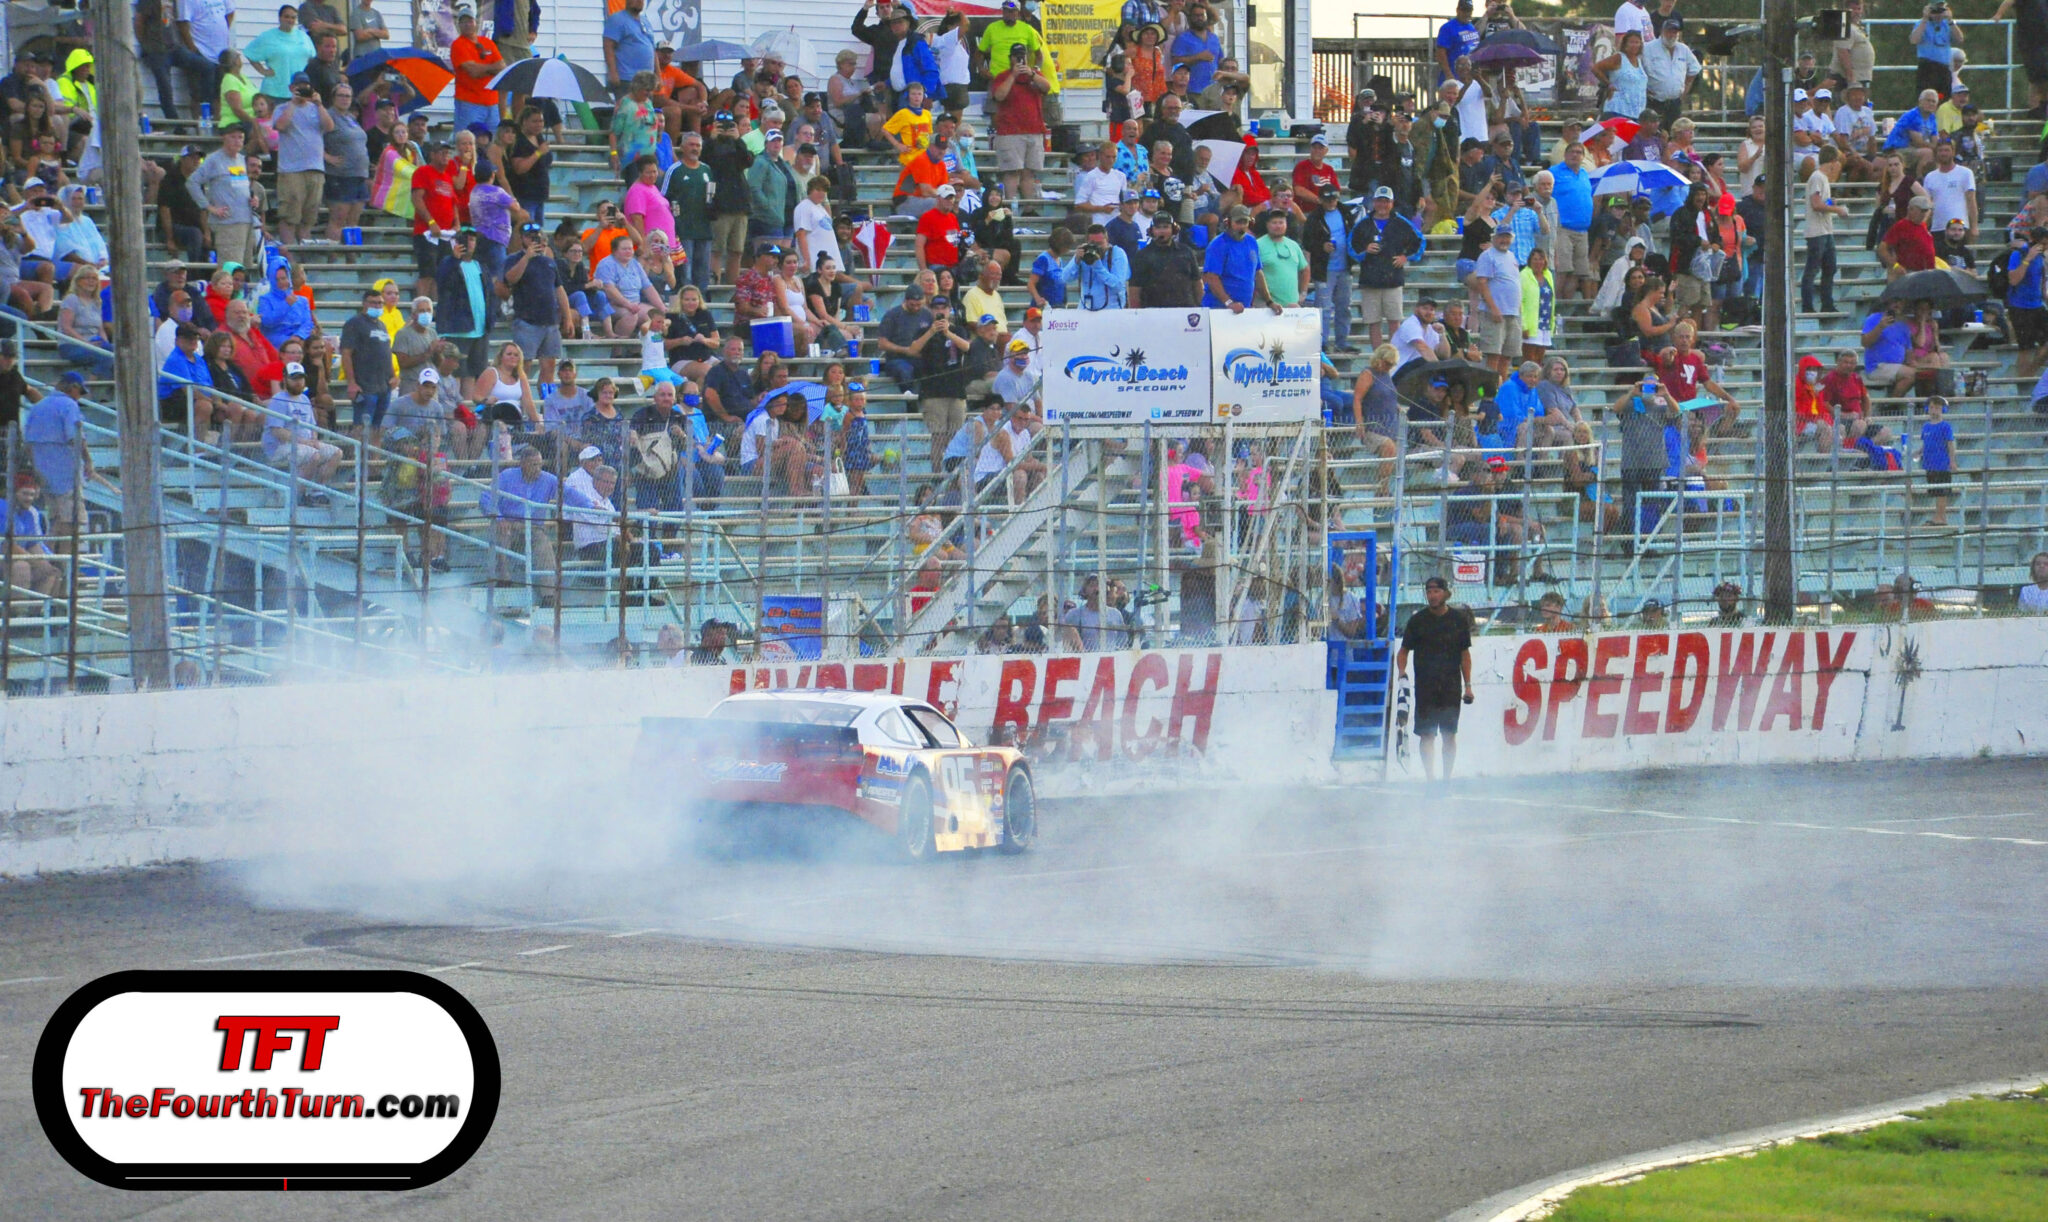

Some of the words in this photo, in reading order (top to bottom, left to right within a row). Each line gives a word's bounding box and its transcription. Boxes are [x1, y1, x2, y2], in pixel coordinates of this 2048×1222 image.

[1046, 4, 1094, 16] TRACKSIDE
[1046, 18, 1117, 31] ENVIRONMENTAL
[1046, 33, 1088, 45] SERVICES
[1048, 320, 1079, 330] Hoosier
[1078, 366, 1132, 385] Myrtle
[1136, 364, 1189, 381] Beach
[1233, 362, 1274, 388] Myrtle
[1277, 361, 1313, 382] Beach
[1117, 384, 1187, 393] SPEEDWAY
[1262, 389, 1312, 398] SPEEDWAY
[1503, 631, 1857, 746] SPEEDWAY
[988, 652, 1223, 762] BEACH
